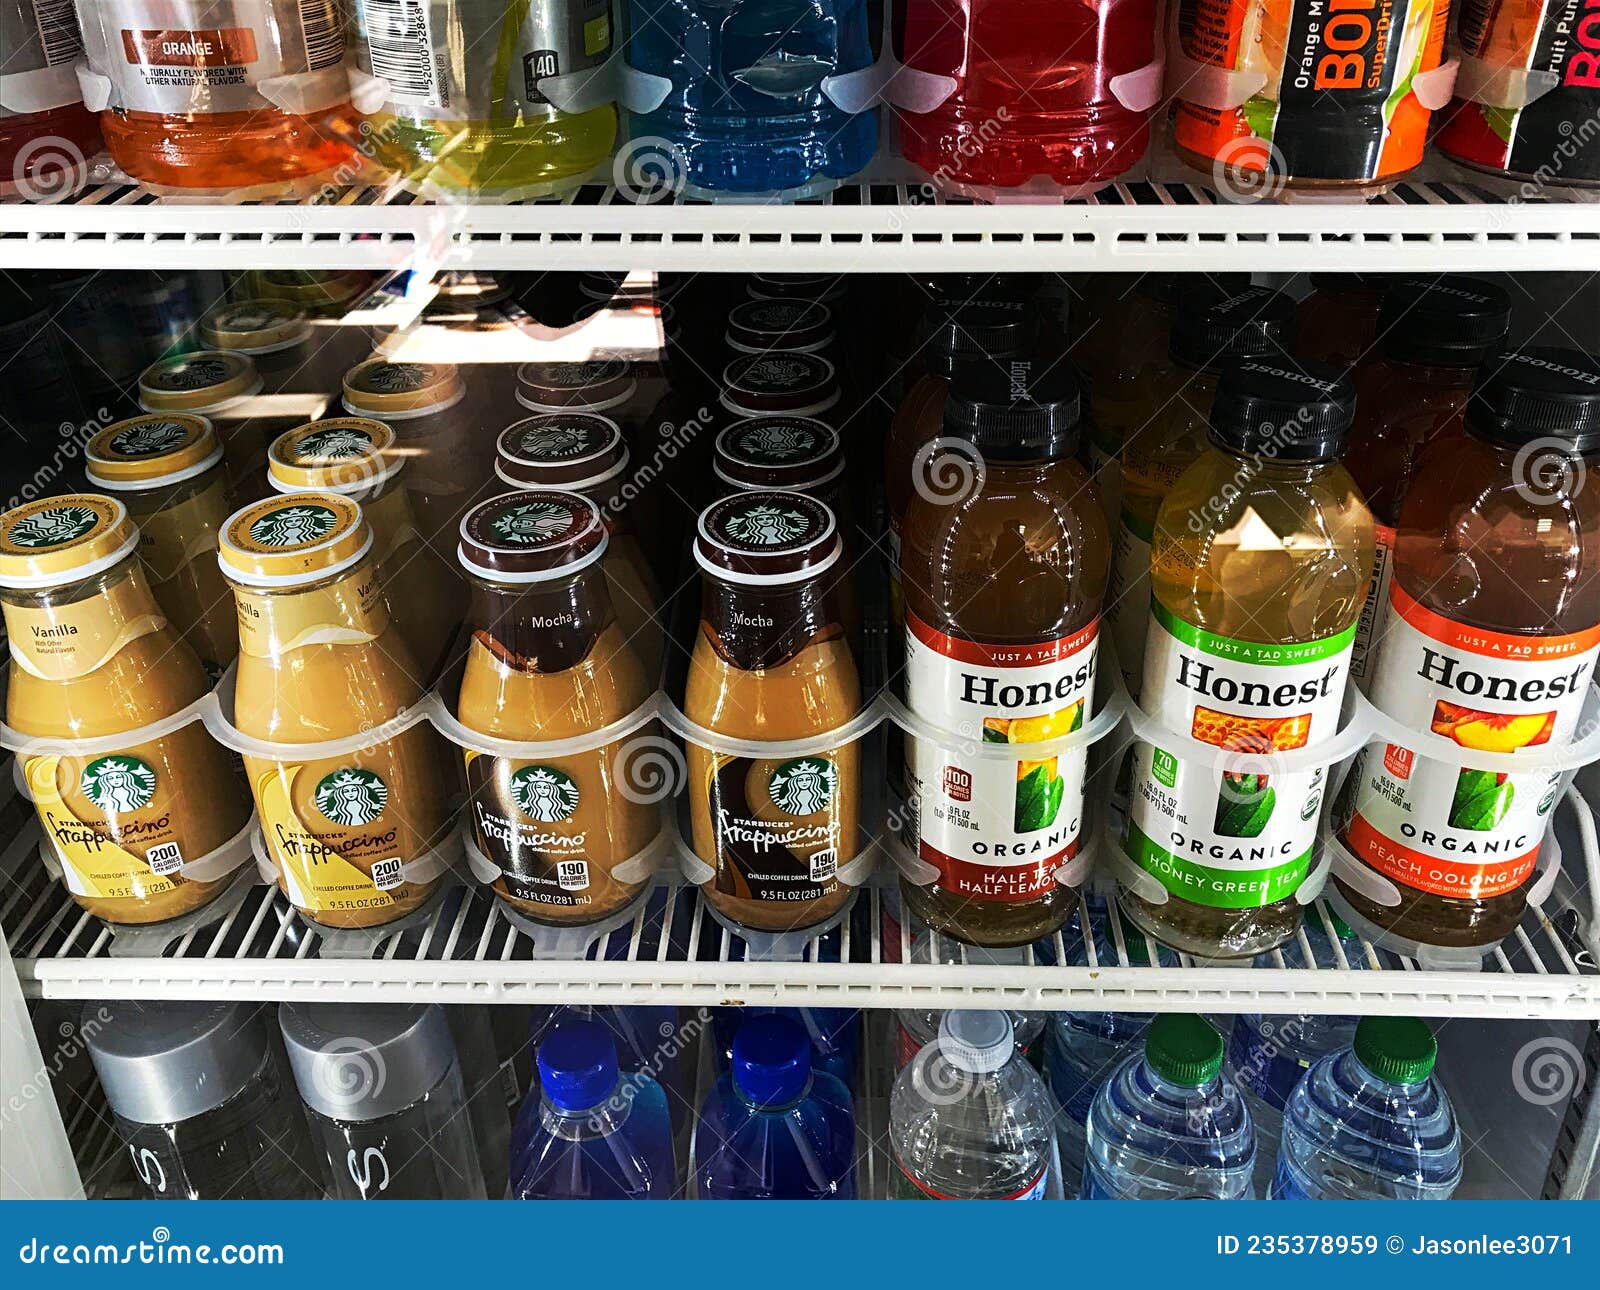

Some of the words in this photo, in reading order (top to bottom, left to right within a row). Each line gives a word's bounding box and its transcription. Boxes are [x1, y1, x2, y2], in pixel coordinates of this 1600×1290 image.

[414, 7, 428, 44] 32868
[1556, 0, 1580, 34] Pun
[162, 42, 214, 56] ORANGE
[1294, 22, 1320, 89] Orange
[140, 68, 181, 77] NTURALLY
[227, 67, 248, 76] WITH
[420, 49, 433, 85] 52000
[527, 54, 556, 78] 140
[146, 77, 170, 86] OTHER
[208, 76, 246, 86] FLAVORS
[1010, 360, 1032, 401] Honest
[1239, 361, 1341, 394] Honest
[531, 613, 573, 629] Mocha
[733, 612, 774, 628] Mocha
[31, 623, 79, 639] Vanilla
[1209, 639, 1239, 653] JUST
[1243, 648, 1251, 656] A
[1256, 650, 1282, 662] TAD
[1456, 633, 1488, 648] JUST
[1492, 642, 1501, 651] A
[1506, 644, 1533, 657] TAD
[991, 653, 1020, 661] JUST
[1037, 648, 1058, 663] TAD
[959, 647, 1098, 708] Honest
[1175, 653, 1336, 708] Honest
[1416, 645, 1586, 703] Honest
[1158, 751, 1172, 770] 70
[1391, 745, 1407, 763] 70
[945, 768, 969, 787] 100
[1380, 775, 1391, 791] 16.9
[1396, 788, 1406, 798] OZ
[1146, 781, 1158, 797] 16.9
[1158, 790, 1167, 804] FL
[1168, 796, 1178, 810] OZ
[1391, 793, 1403, 808] 500
[1402, 801, 1413, 813] mL
[733, 818, 790, 828] STARBUCKS
[954, 807, 961, 817] FL
[962, 810, 970, 820] OZ
[957, 816, 969, 829] 500
[970, 819, 980, 831] mL
[1161, 803, 1175, 819] 500
[1176, 811, 1189, 825] mL
[59, 820, 111, 828] STARBUCK
[720, 809, 840, 854] frappuccino
[276, 823, 397, 866] frappuccino
[972, 817, 1078, 857] ORGANIC
[1170, 831, 1293, 861] ORGANIC
[1400, 822, 1527, 854] ORGANIC
[150, 844, 178, 863] 200
[363, 849, 383, 857] coffee
[383, 843, 398, 852] drink
[569, 847, 586, 855] drink
[813, 850, 836, 868] 190
[153, 856, 181, 869] CALORIES
[374, 859, 400, 877] 200
[560, 862, 585, 876] 190
[1368, 839, 1422, 876] PEACH
[1428, 869, 1508, 886] OOLONG
[1512, 859, 1532, 878] TEA
[376, 873, 401, 883] CALORIE
[540, 877, 559, 886] DRINK
[748, 873, 770, 881] CHILLED
[790, 873, 809, 881] DRINK
[984, 871, 1027, 884] HALF
[1033, 863, 1057, 879] TEA
[1150, 853, 1206, 889] HONEY
[1211, 879, 1270, 893] GREEN
[1276, 869, 1298, 888] TEA
[1383, 864, 1413, 882] NATURALLY
[1413, 877, 1443, 891] FLAVORED
[108, 888, 124, 897] 9.5
[149, 881, 171, 894] (281
[334, 884, 355, 892] COFFEE
[355, 883, 373, 891] DRINK
[760, 890, 776, 900] 9.5
[777, 891, 787, 900] FL
[788, 890, 800, 900] OZ
[801, 889, 821, 901] (281
[823, 881, 838, 896] mL)
[960, 879, 1002, 895] HALF
[1009, 875, 1056, 895] LEMO
[330, 900, 344, 909] 9.5
[346, 899, 356, 908] FL
[357, 898, 370, 908] OZ
[370, 896, 390, 909] (281
[393, 889, 410, 905] mL)
[516, 888, 530, 900] 9.5
[530, 891, 540, 902] FL
[540, 893, 552, 903] OZ
[552, 895, 573, 906] (281
[575, 894, 592, 905] mL)
